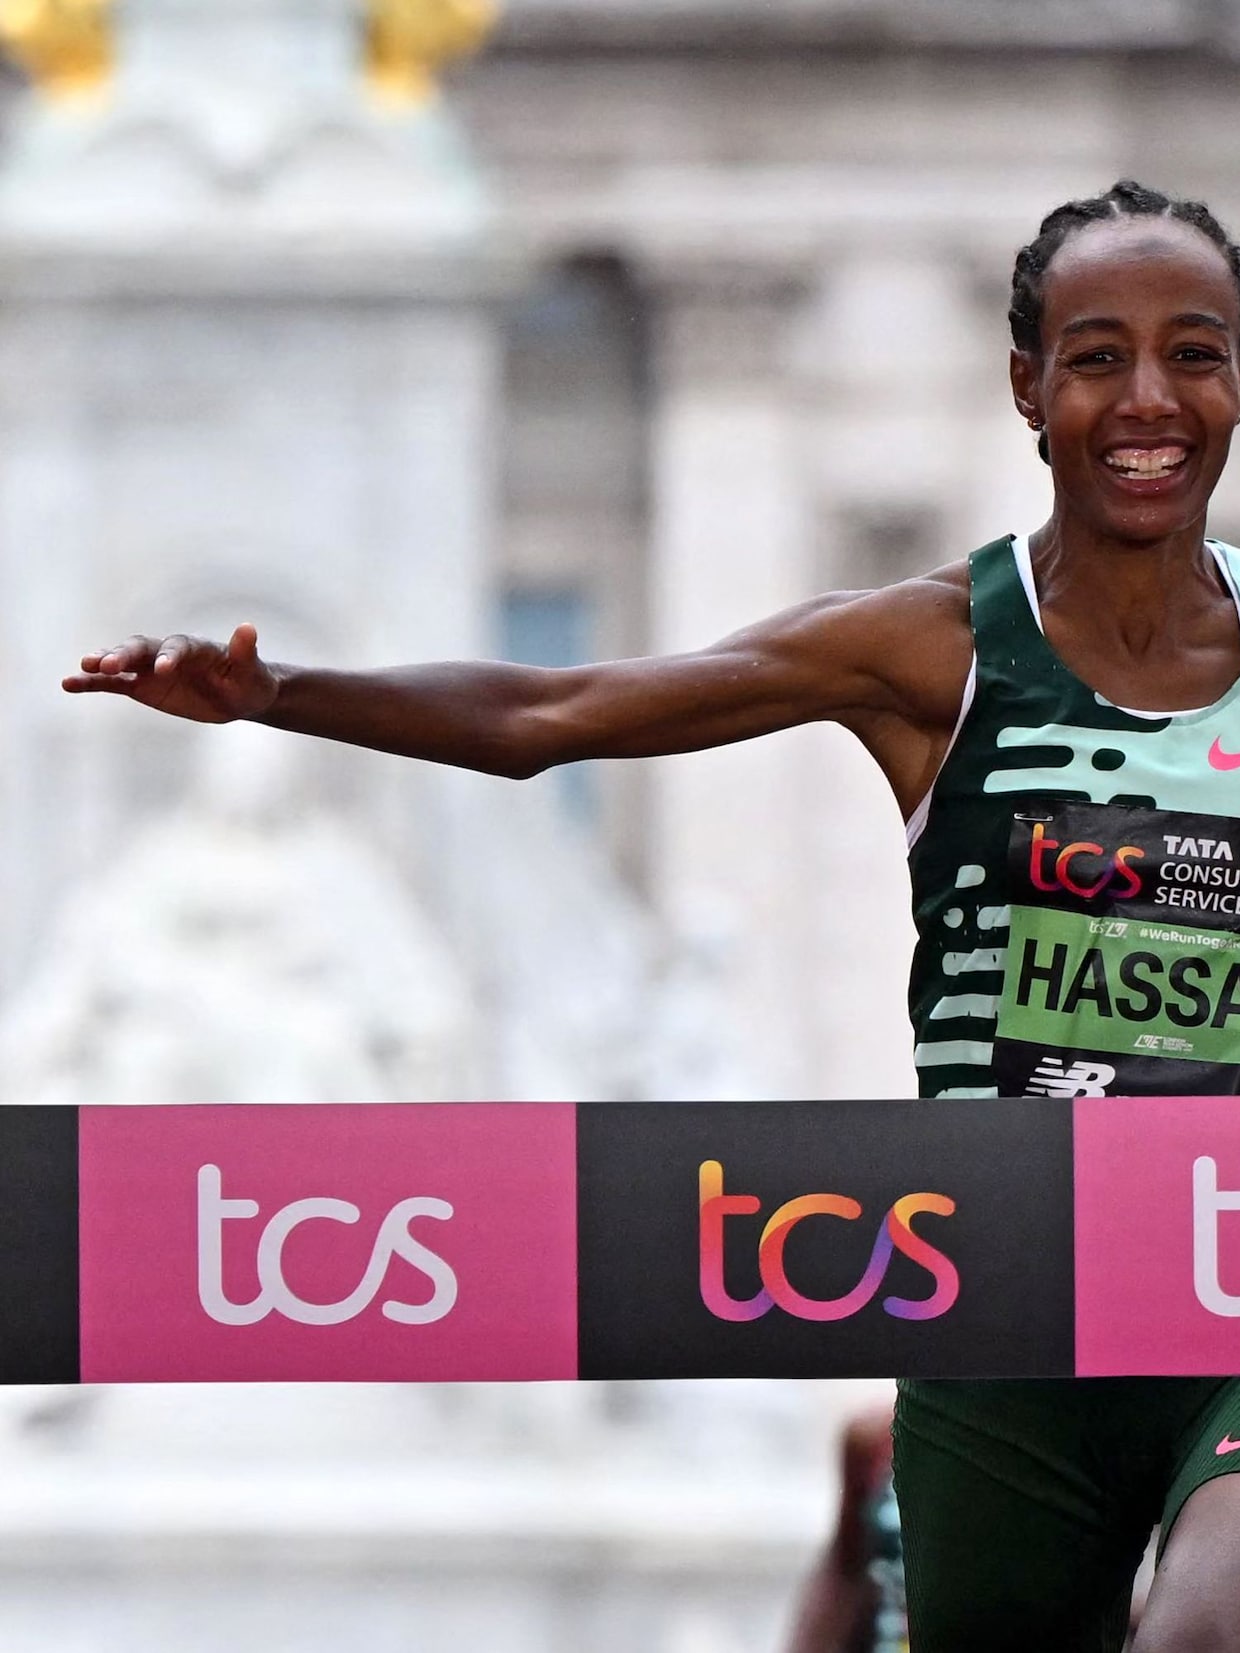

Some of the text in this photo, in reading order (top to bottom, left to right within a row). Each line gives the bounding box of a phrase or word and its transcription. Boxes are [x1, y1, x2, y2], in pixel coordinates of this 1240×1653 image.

[1029, 823, 1145, 899] tcs
[1163, 835, 1234, 861] TATA
[198, 1164, 457, 1325] tcs
[699, 1160, 960, 1321] tcs
